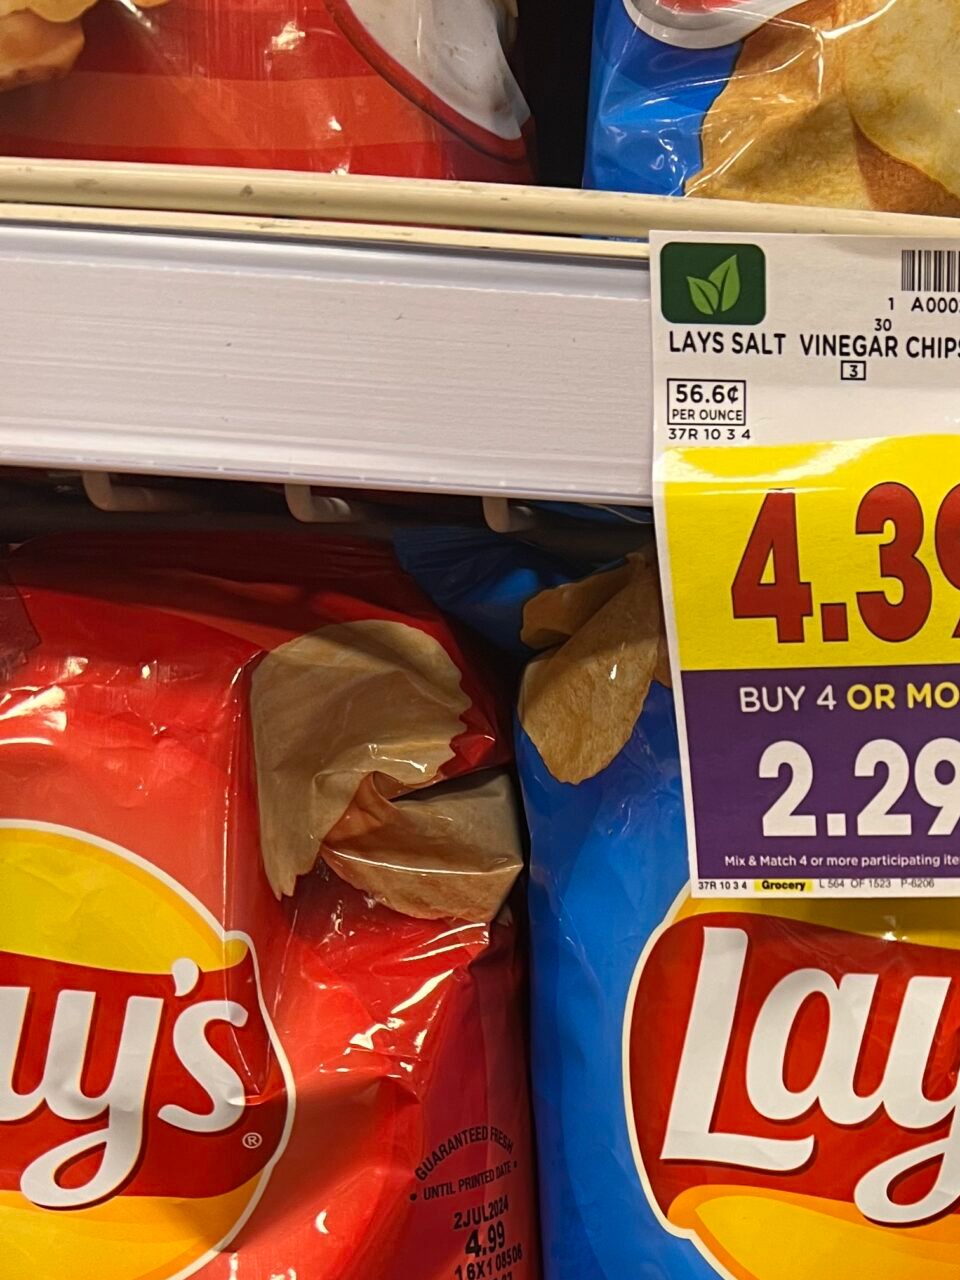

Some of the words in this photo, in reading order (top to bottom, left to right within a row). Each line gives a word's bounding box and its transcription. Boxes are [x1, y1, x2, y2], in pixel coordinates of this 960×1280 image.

[887, 298, 894, 310] 1
[874, 319, 892, 331] 30
[669, 331, 725, 354] LAYS
[732, 332, 786, 355] SALT
[800, 334, 898, 357] VINEGAR
[849, 365, 858, 377] 3
[675, 385, 739, 404] 56.6¢
[672, 409, 695, 421] PER
[699, 410, 744, 422] OUNCE
[668, 428, 698, 440] 37R
[704, 429, 721, 440] 10
[726, 429, 735, 440] 3
[741, 429, 750, 440] 4
[739, 686, 806, 713] BUY
[816, 685, 837, 711] 4
[846, 684, 896, 710] OR
[725, 855, 746, 866] Mix
[749, 856, 757, 866] &
[760, 854, 797, 866] Match
[799, 855, 808, 866] 4
[810, 857, 824, 866] or
[826, 857, 858, 866] more
[861, 853, 941, 869] participating
[698, 881, 718, 890] 37R
[720, 881, 731, 890] 10
[733, 881, 739, 890] 3
[741, 881, 748, 890] 4
[762, 880, 806, 892] Grocery
[819, 880, 825, 889] L
[850, 879, 866, 889] OF
[414, 1126, 488, 1181] GUARANTEED
[490, 1126, 514, 1155] FRESH
[423, 1182, 456, 1201] UNTIL
[459, 1170, 495, 1193] PRINTED
[496, 1161, 512, 1180] DATE
[453, 1194, 509, 1230] 2JUL2024
[465, 1221, 505, 1258] 4.99
